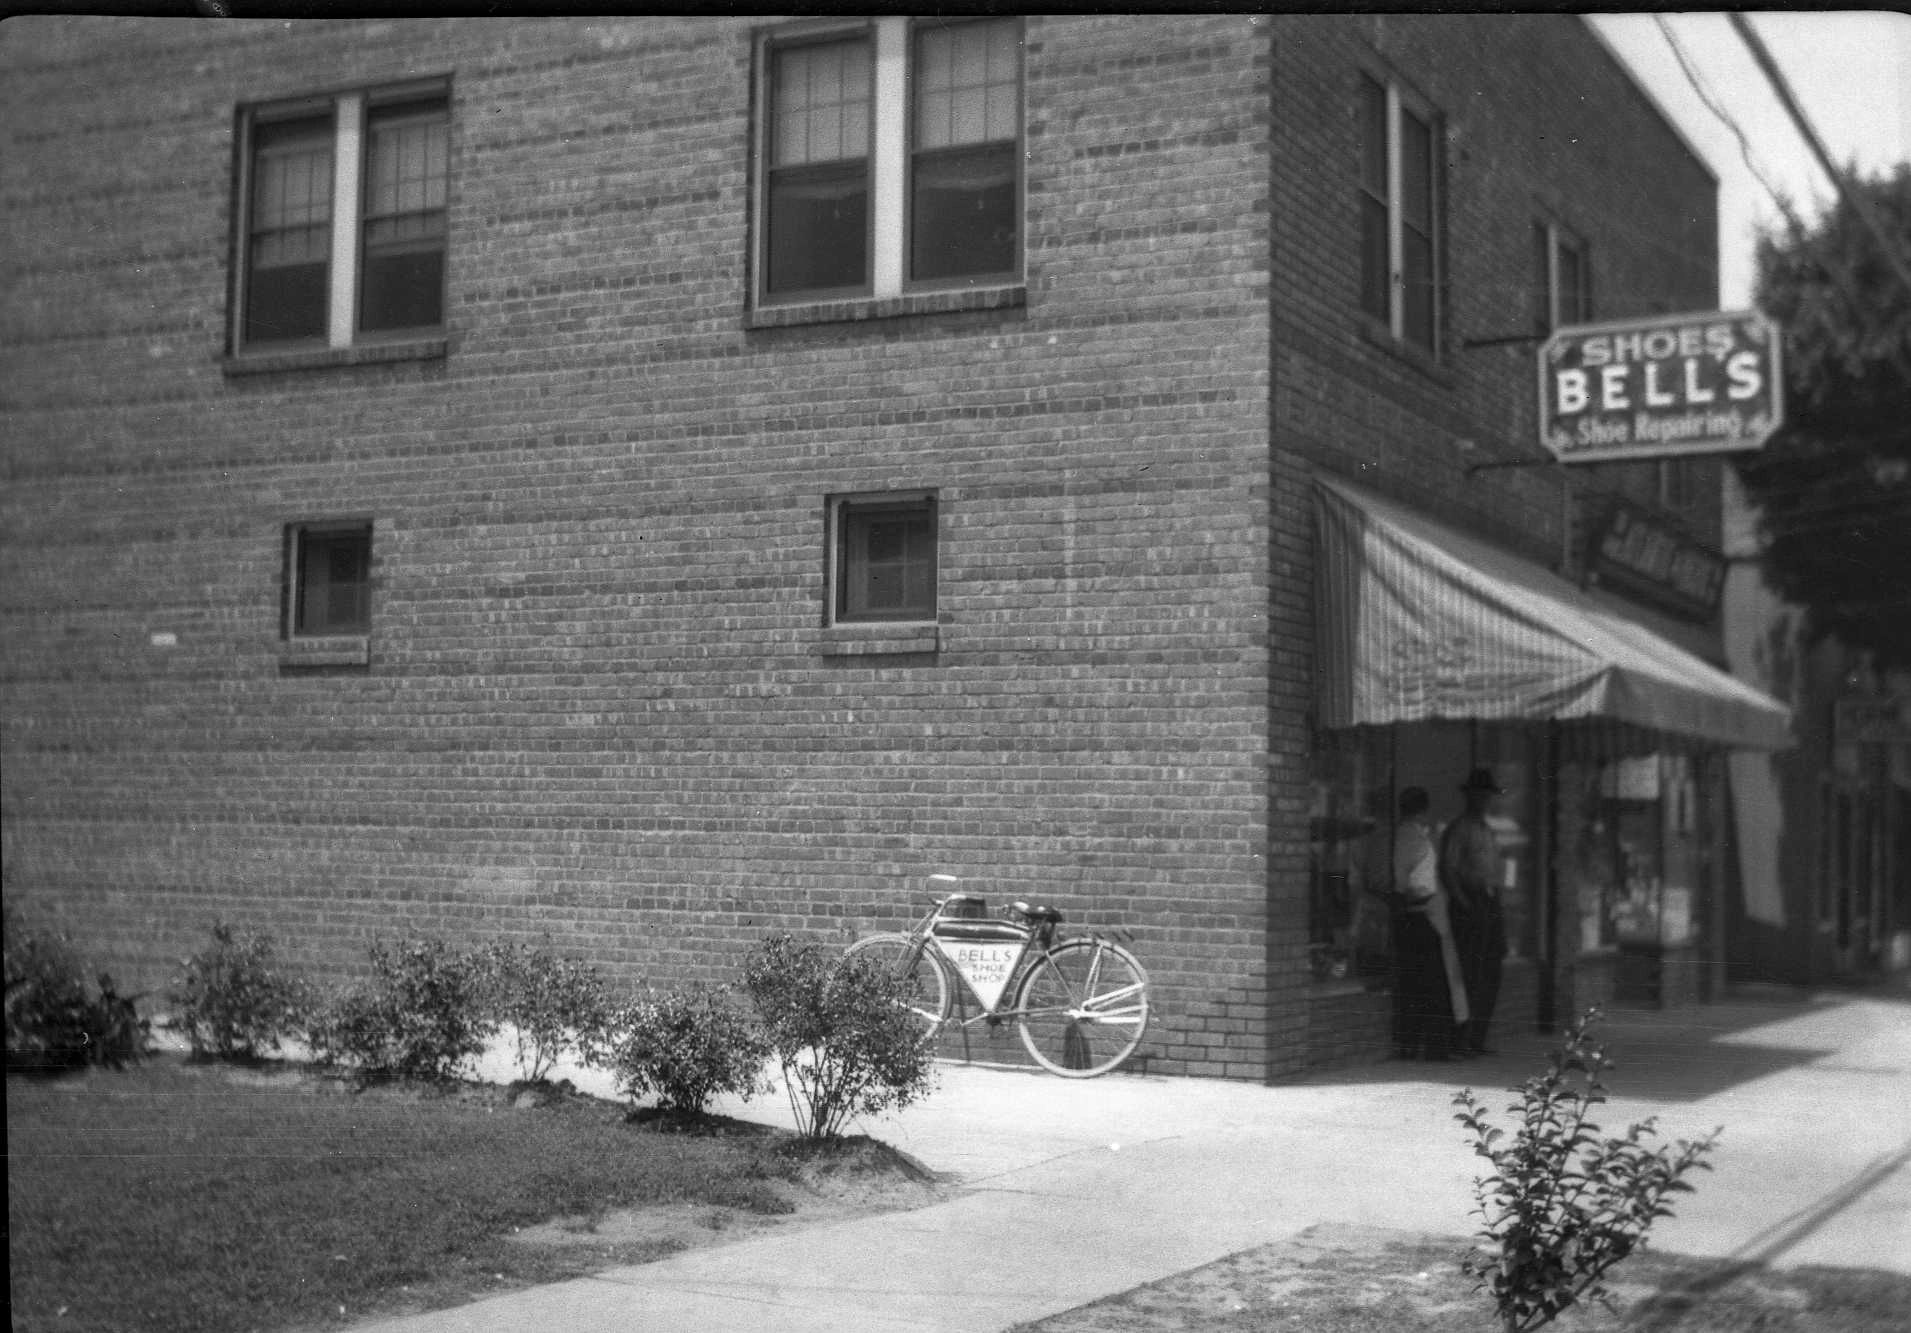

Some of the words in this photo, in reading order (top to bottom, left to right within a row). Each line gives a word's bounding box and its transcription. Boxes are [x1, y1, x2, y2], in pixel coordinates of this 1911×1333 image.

[1582, 325, 1735, 366] SHOES
[1577, 418, 1630, 444] Shoe
[1634, 408, 1743, 442] Repairing
[971, 974, 1005, 983] SHOP
[972, 963, 1006, 973] SHOE
